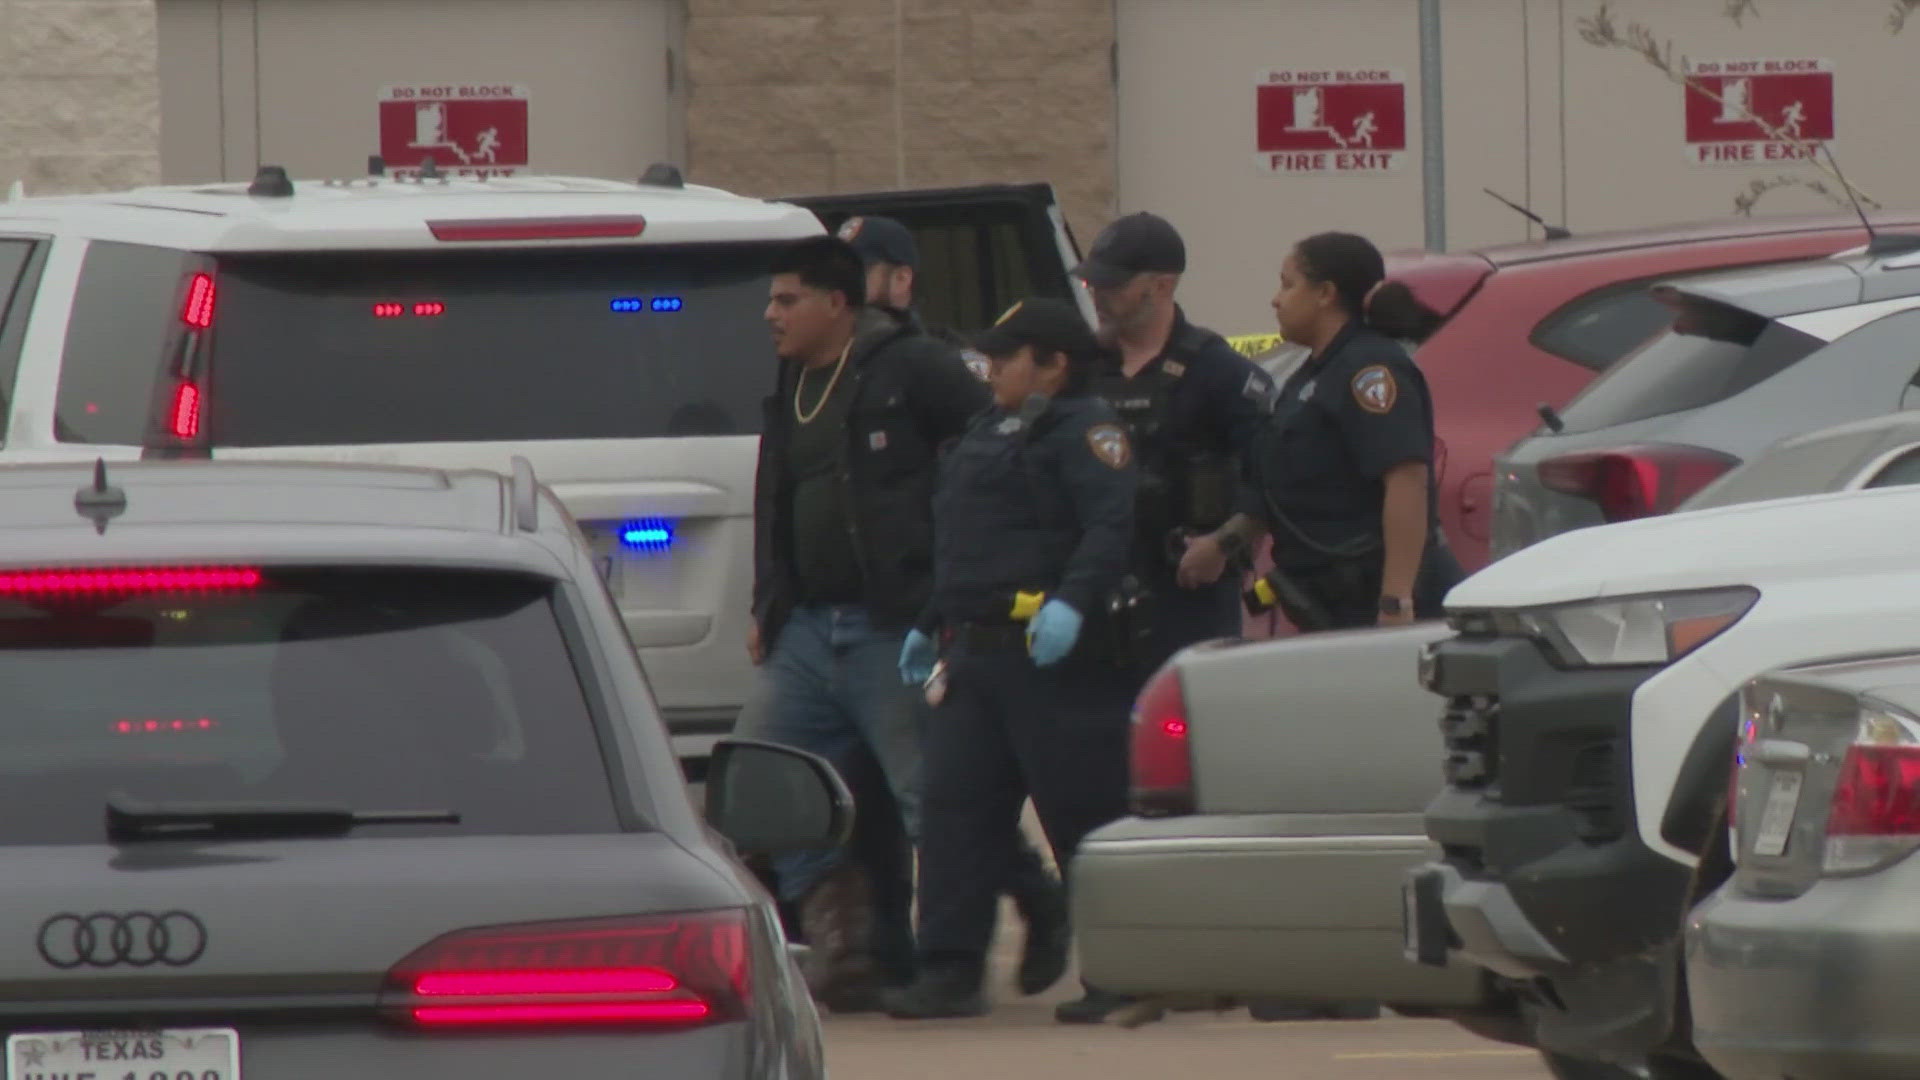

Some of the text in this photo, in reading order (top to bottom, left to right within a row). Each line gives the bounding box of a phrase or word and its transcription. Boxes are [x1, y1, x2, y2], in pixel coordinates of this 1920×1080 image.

[1698, 60, 1819, 73] DO NOT BLOCK
[1269, 70, 1391, 82] DO NOT BLOCK
[392, 85, 513, 98] DO NOT BLOCK
[1698, 145, 1755, 161] FIRE
[1270, 153, 1392, 171] FIRE EXIT
[80, 1040, 165, 1061] TEXAS
